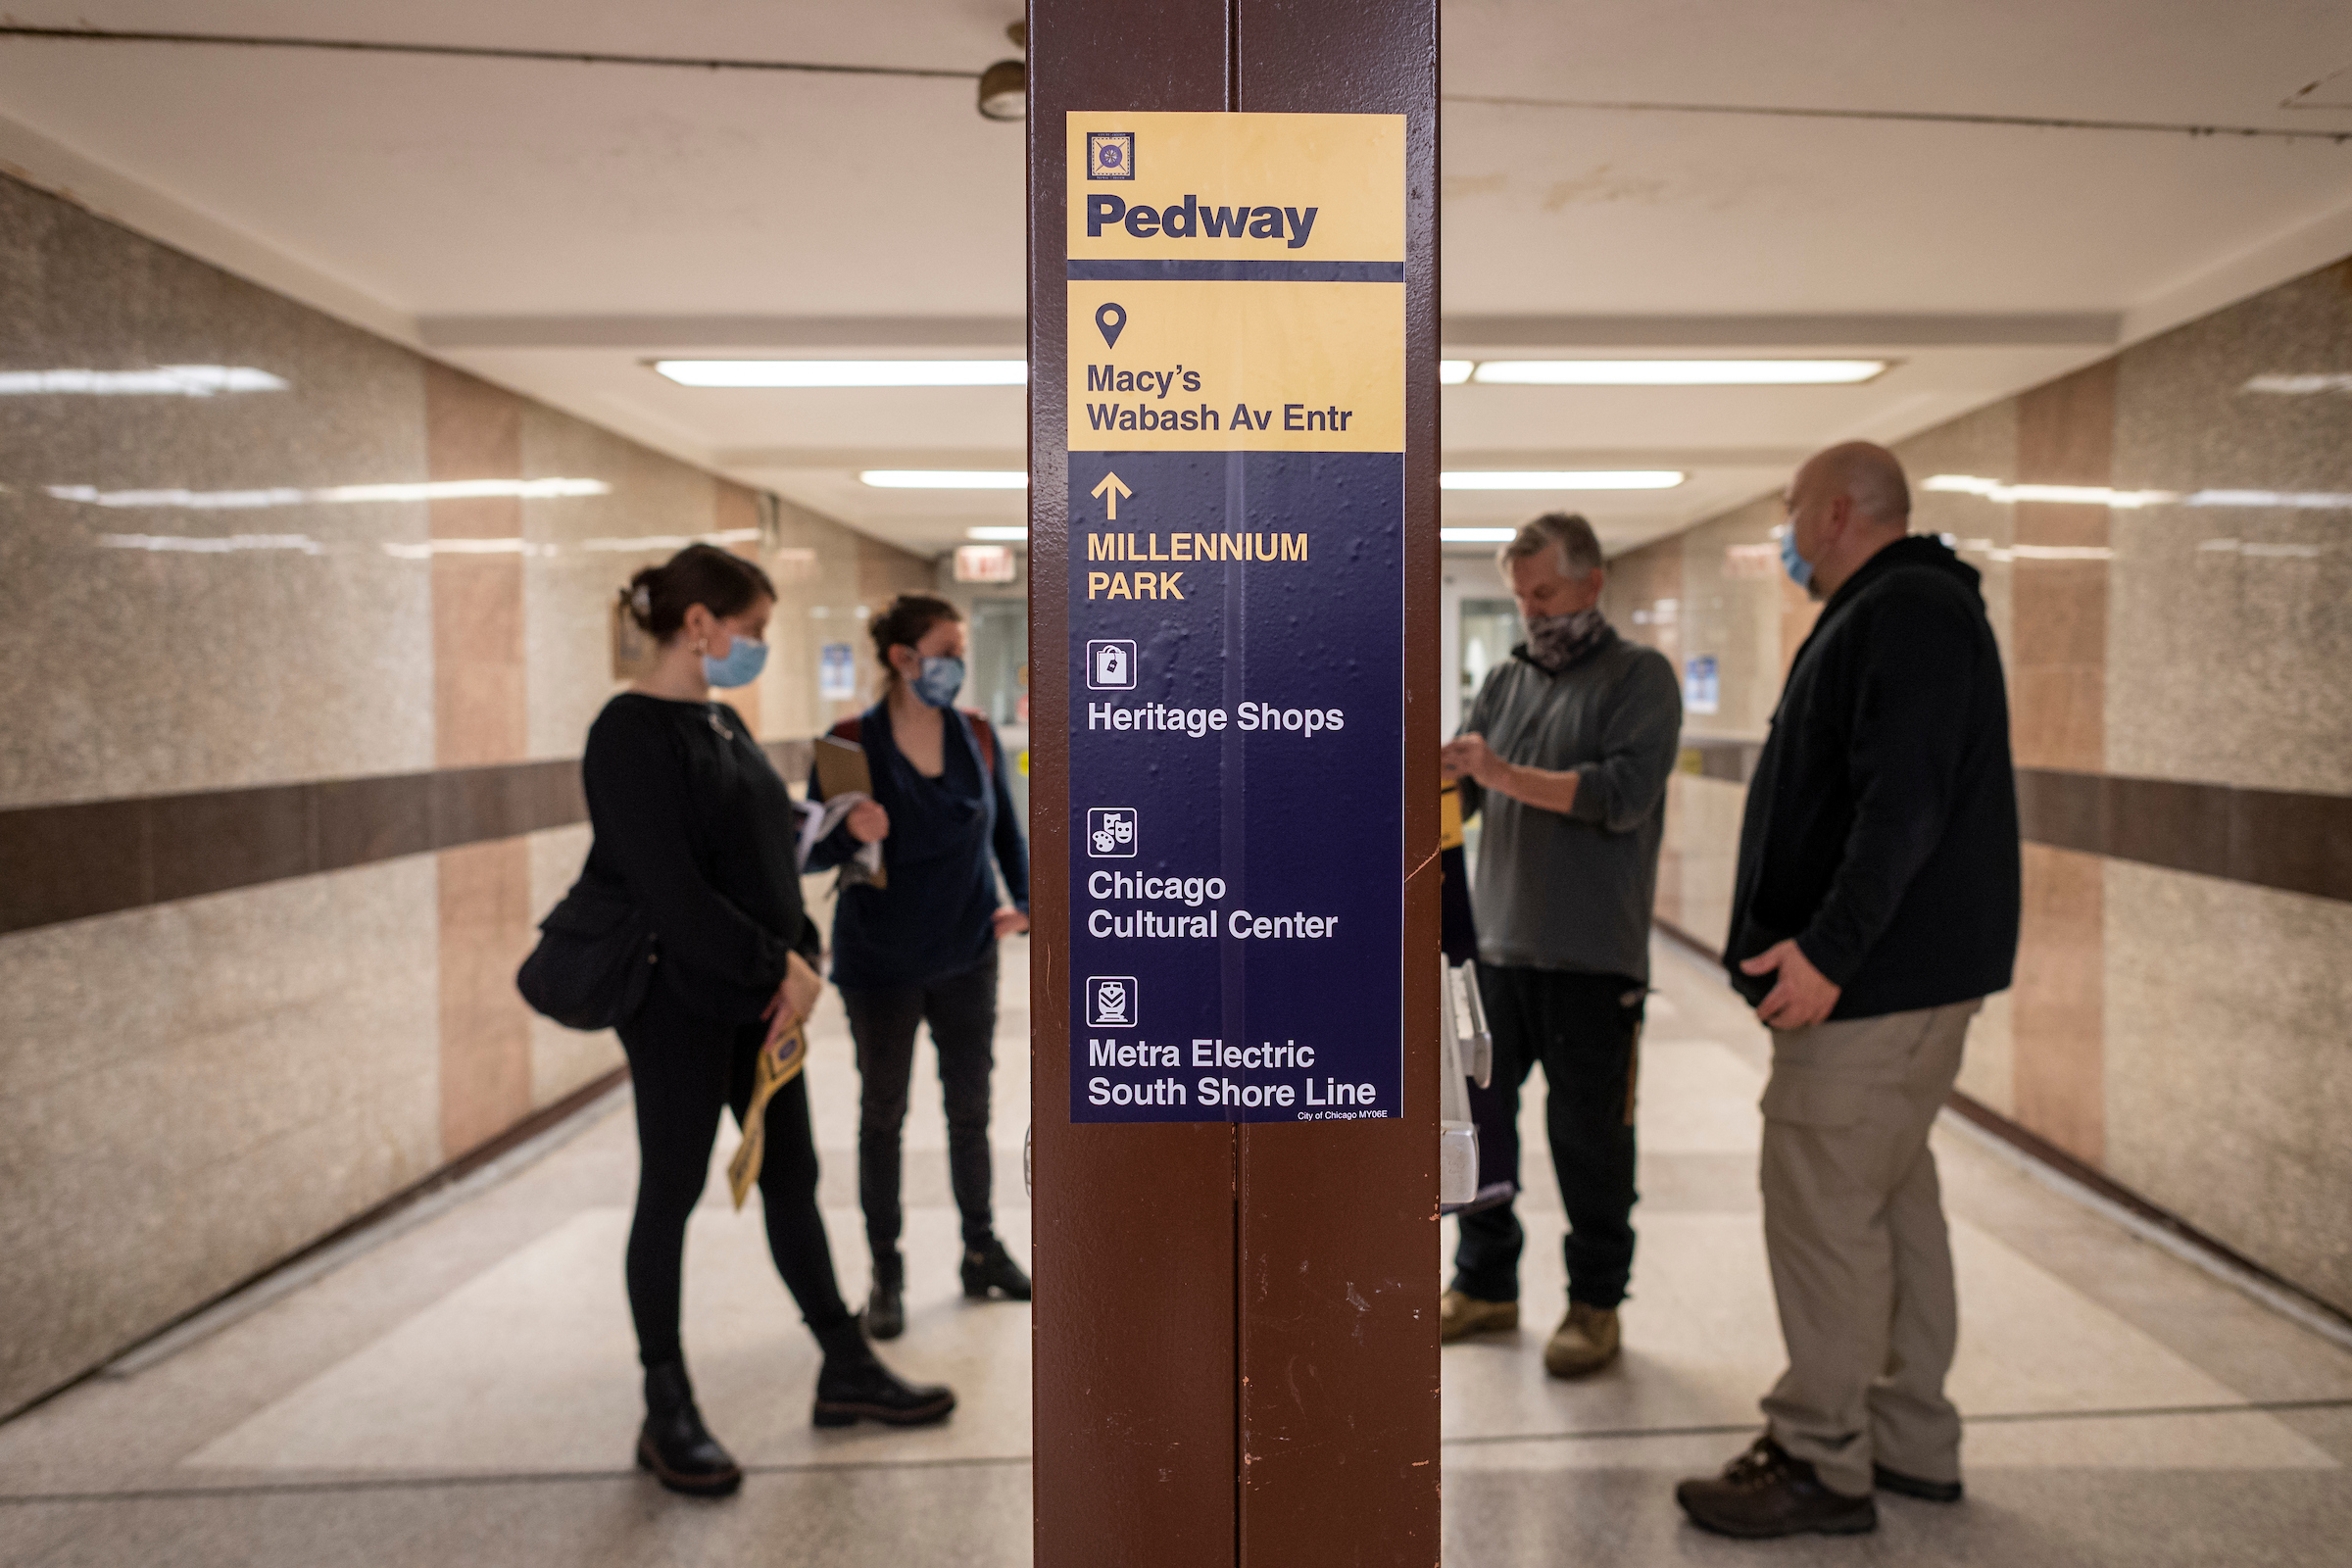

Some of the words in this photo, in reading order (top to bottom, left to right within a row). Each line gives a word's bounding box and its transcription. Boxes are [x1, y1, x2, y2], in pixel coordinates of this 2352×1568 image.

[1087, 194, 1319, 249] Pedway
[1087, 365, 1201, 399] Macy’s
[1087, 404, 1219, 431] Wabash
[1230, 404, 1272, 431] Av
[1284, 405, 1353, 431] Entr
[1087, 533, 1308, 562] MILLENNIUM
[1088, 572, 1185, 600] PARK
[1088, 702, 1228, 737] Heritage
[1237, 702, 1345, 738] Shops
[1088, 871, 1226, 906] Chicago
[1088, 909, 1217, 938] Cultural
[1228, 910, 1339, 939] Center
[1089, 1039, 1181, 1067] Metra
[1192, 1039, 1315, 1068] Electric
[1088, 1077, 1187, 1105] South
[1198, 1077, 1296, 1106] Shore
[1306, 1077, 1377, 1105] Line
[1298, 1111, 1313, 1121] City
[1324, 1110, 1357, 1120] Chicago
[1358, 1109, 1388, 1118] MY06E
